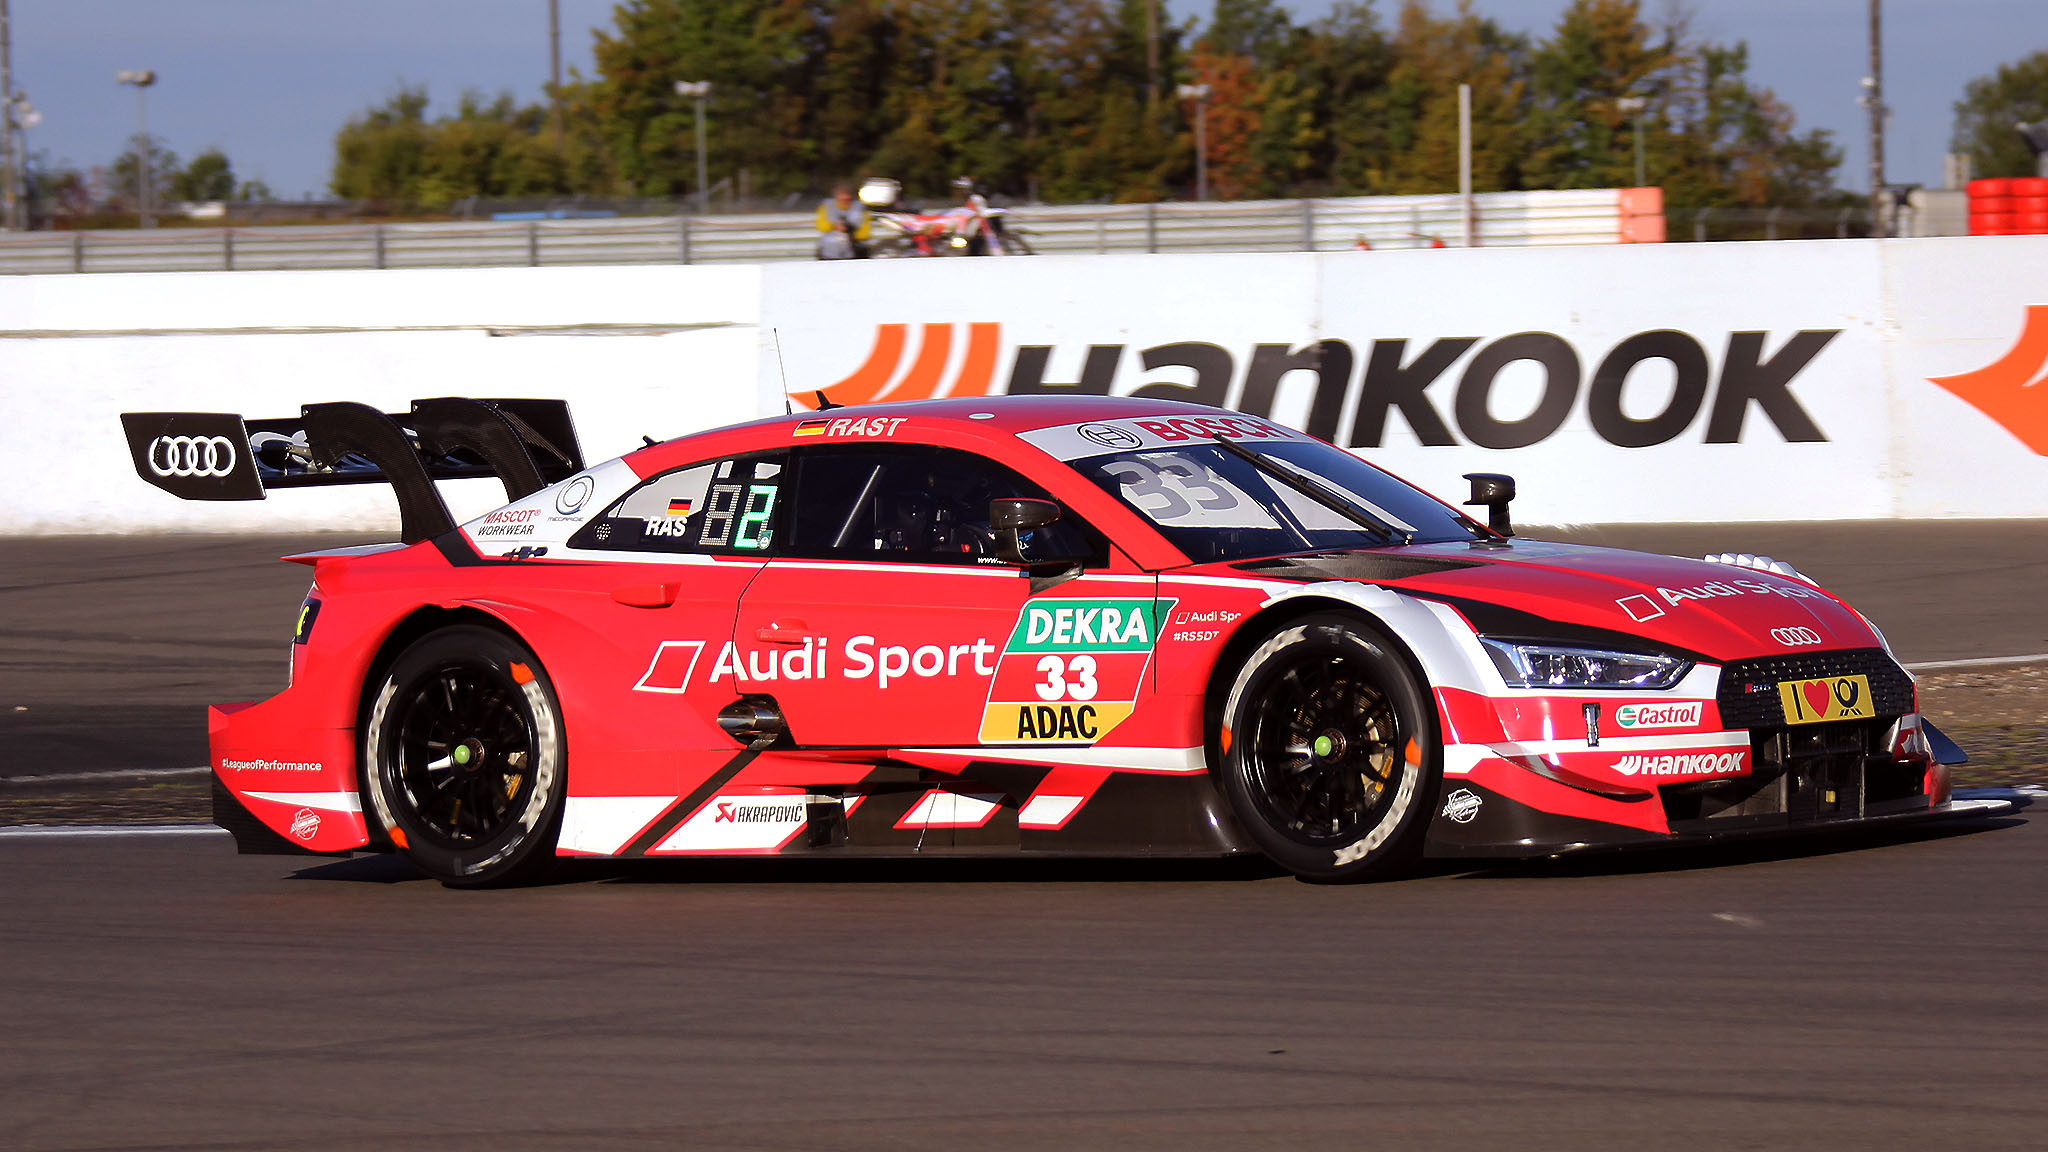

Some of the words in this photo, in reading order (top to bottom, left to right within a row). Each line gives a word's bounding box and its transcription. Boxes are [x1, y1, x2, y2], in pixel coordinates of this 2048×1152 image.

[827, 417, 908, 437] RAST
[1132, 418, 1295, 442] BOSCH
[1100, 456, 1239, 520] 33
[477, 524, 535, 536] WORKWEAR
[645, 516, 688, 537] RAS
[1656, 582, 1744, 607] Audi
[1026, 608, 1149, 644] DEKRA
[1190, 611, 1217, 622] Audi
[708, 636, 827, 683] Audi
[843, 635, 996, 689] Sport
[1034, 655, 1098, 701] 33
[1017, 705, 1098, 739] ADAC
[1637, 705, 1697, 725] Castrol
